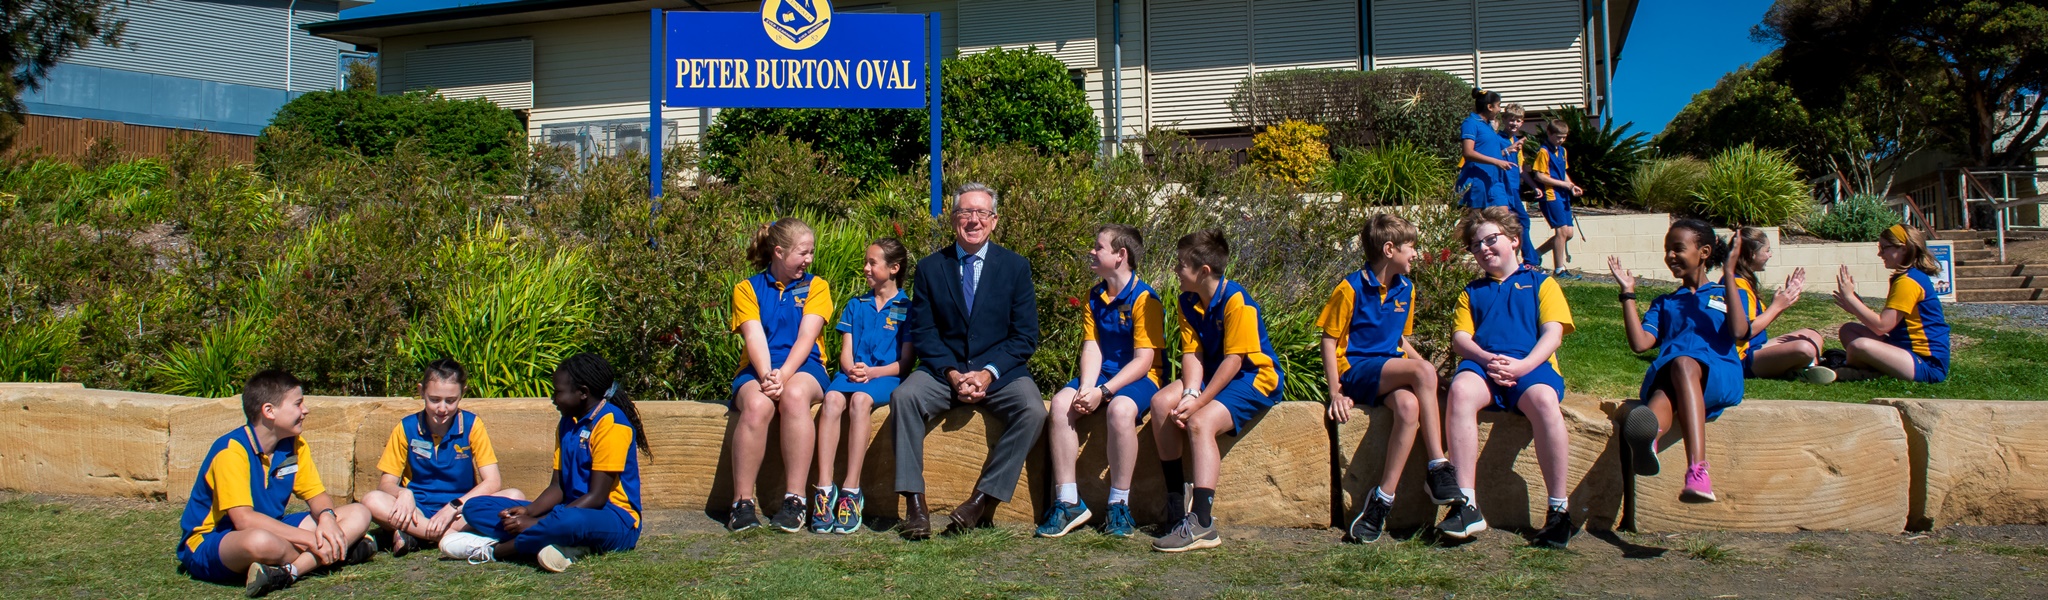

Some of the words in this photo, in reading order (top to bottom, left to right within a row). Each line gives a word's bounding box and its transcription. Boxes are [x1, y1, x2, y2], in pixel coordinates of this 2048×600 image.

[675, 58, 751, 89] PETER
[755, 59, 851, 90] BURTON
[856, 59, 917, 90] OVAL
